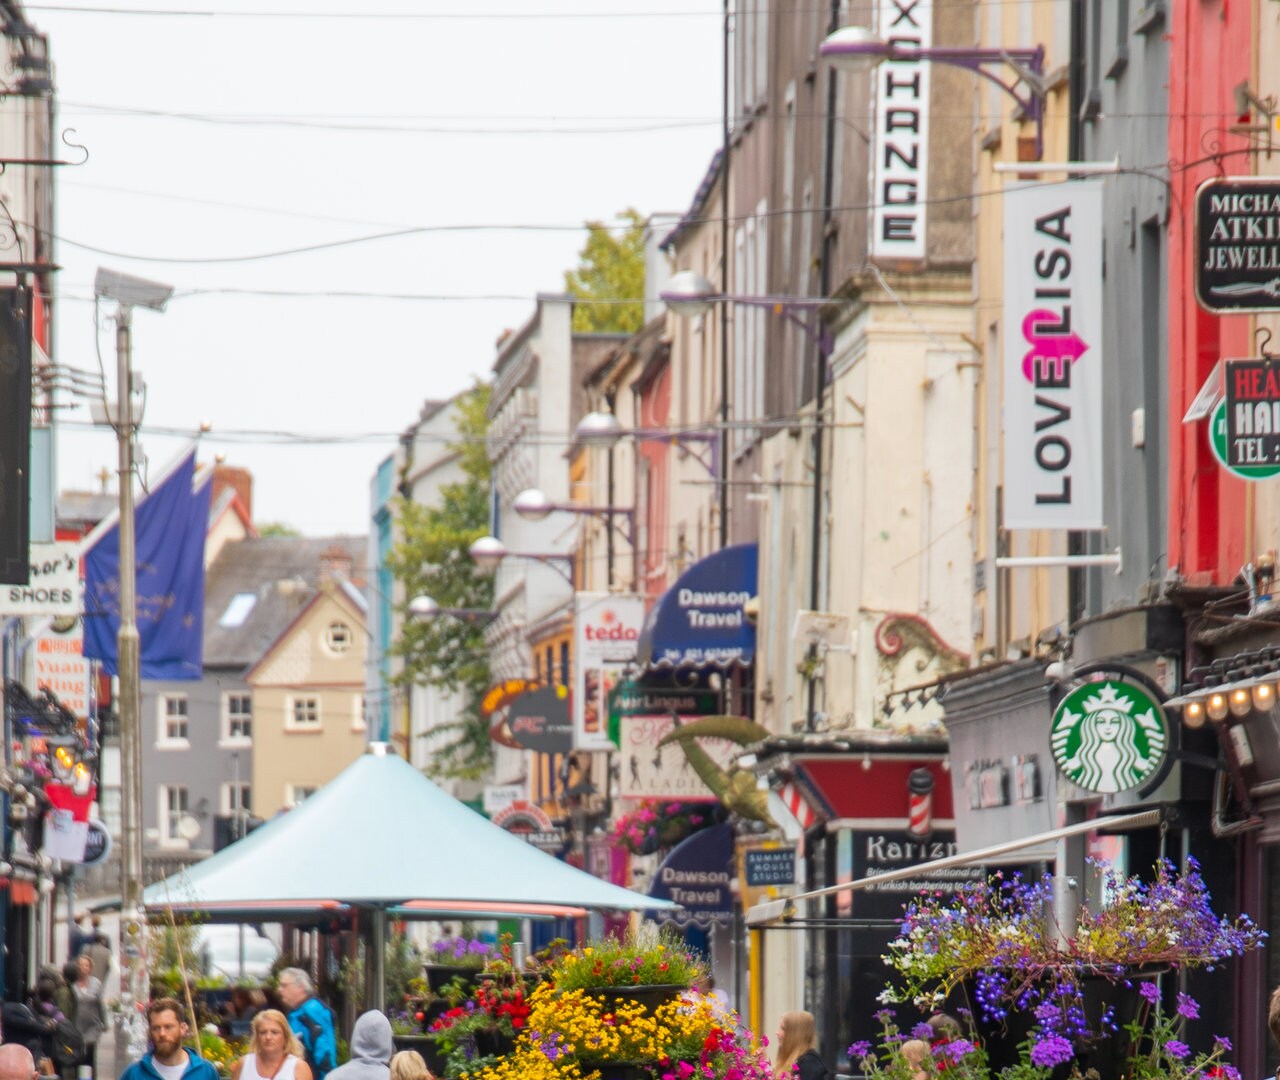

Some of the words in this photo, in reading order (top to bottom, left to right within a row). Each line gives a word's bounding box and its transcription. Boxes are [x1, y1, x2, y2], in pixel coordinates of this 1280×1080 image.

[1234, 438, 1269, 463] TEL
[10, 588, 73, 603] SHOES
[678, 588, 750, 607] Dawson
[687, 609, 743, 628] Travel
[37, 659, 85, 673] Yuan
[37, 676, 85, 695] Ming
[749, 853, 794, 863] SUMMER
[662, 867, 729, 883] Dawson
[754, 862, 791, 872] HOUSE
[752, 871, 793, 881] STUDIO
[671, 887, 721, 903] Travel
